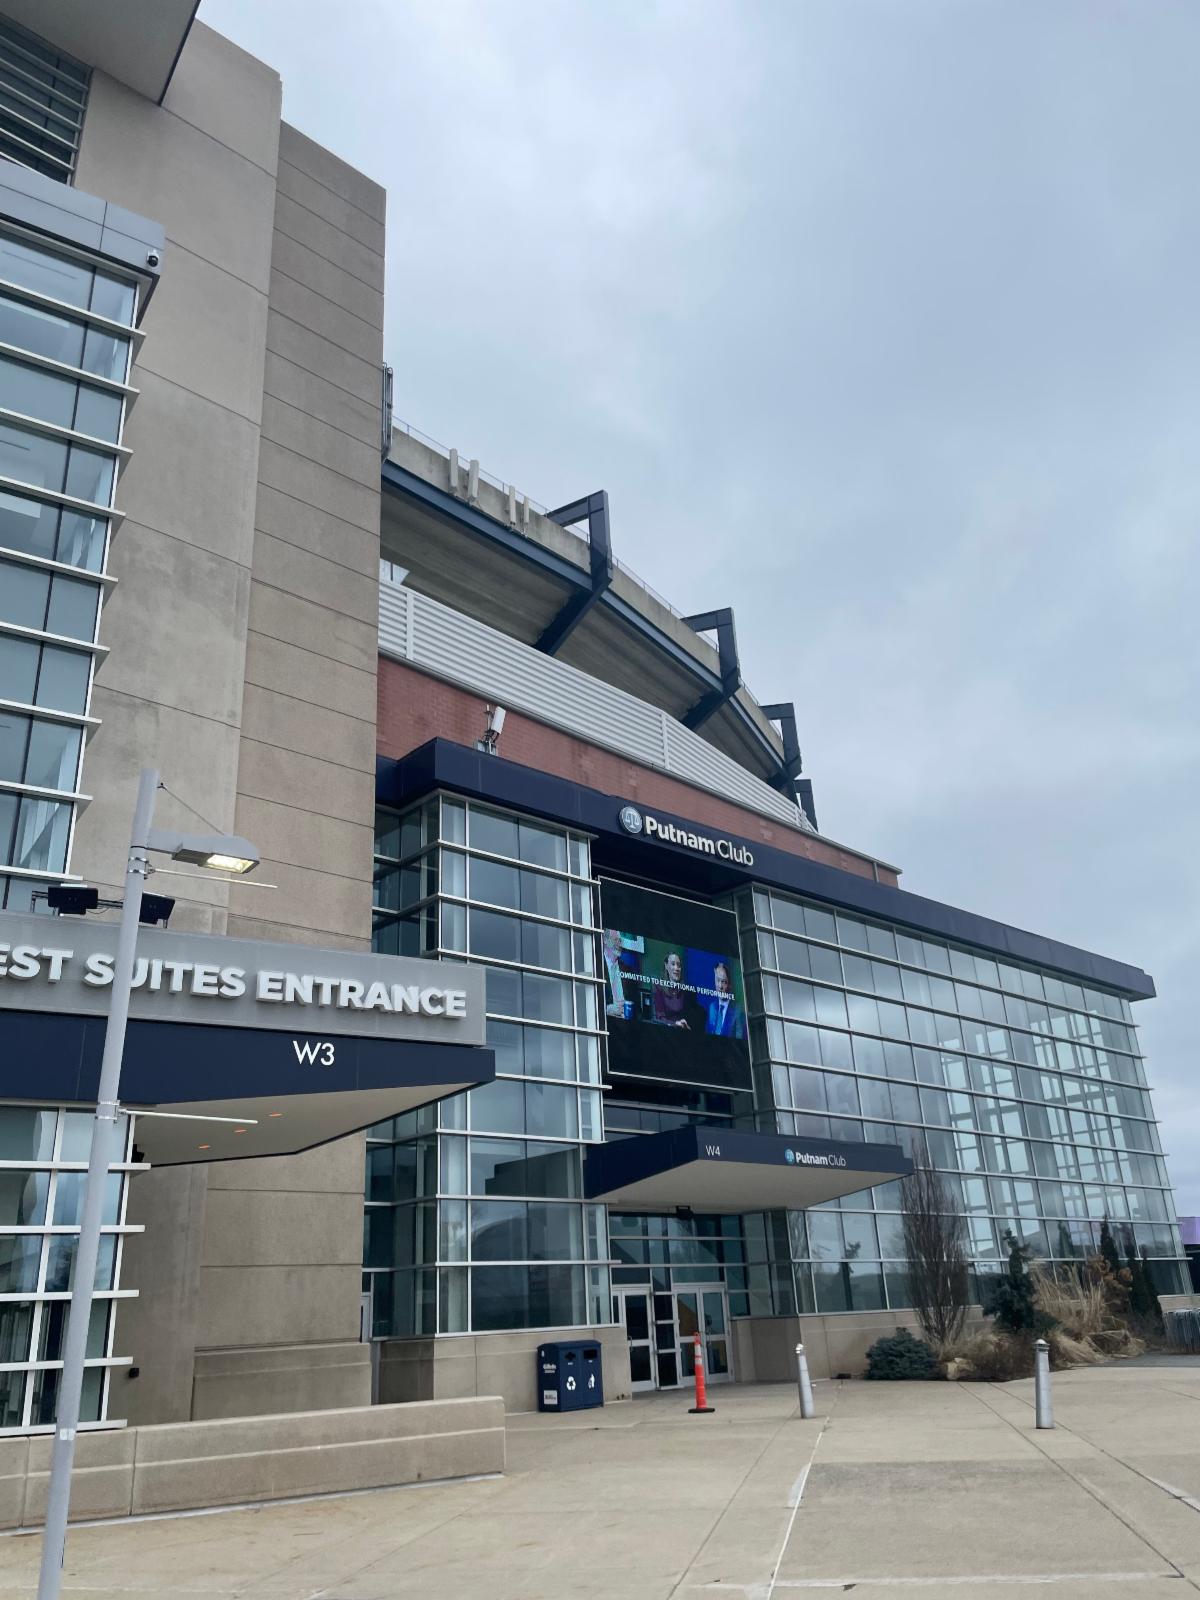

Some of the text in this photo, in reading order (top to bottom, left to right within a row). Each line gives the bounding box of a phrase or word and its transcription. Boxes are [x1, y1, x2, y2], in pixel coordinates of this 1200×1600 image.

[645, 816, 754, 866] Putnam Club
[84, 953, 247, 998] SUITES
[256, 970, 467, 1019] ENTRANCE
[616, 970, 736, 1001] COMMITTED TO EXCEPTIONAL PERFORMANCE
[292, 1040, 335, 1066] W3
[705, 1144, 721, 1157] W4
[796, 1151, 846, 1167] Putnam Club
